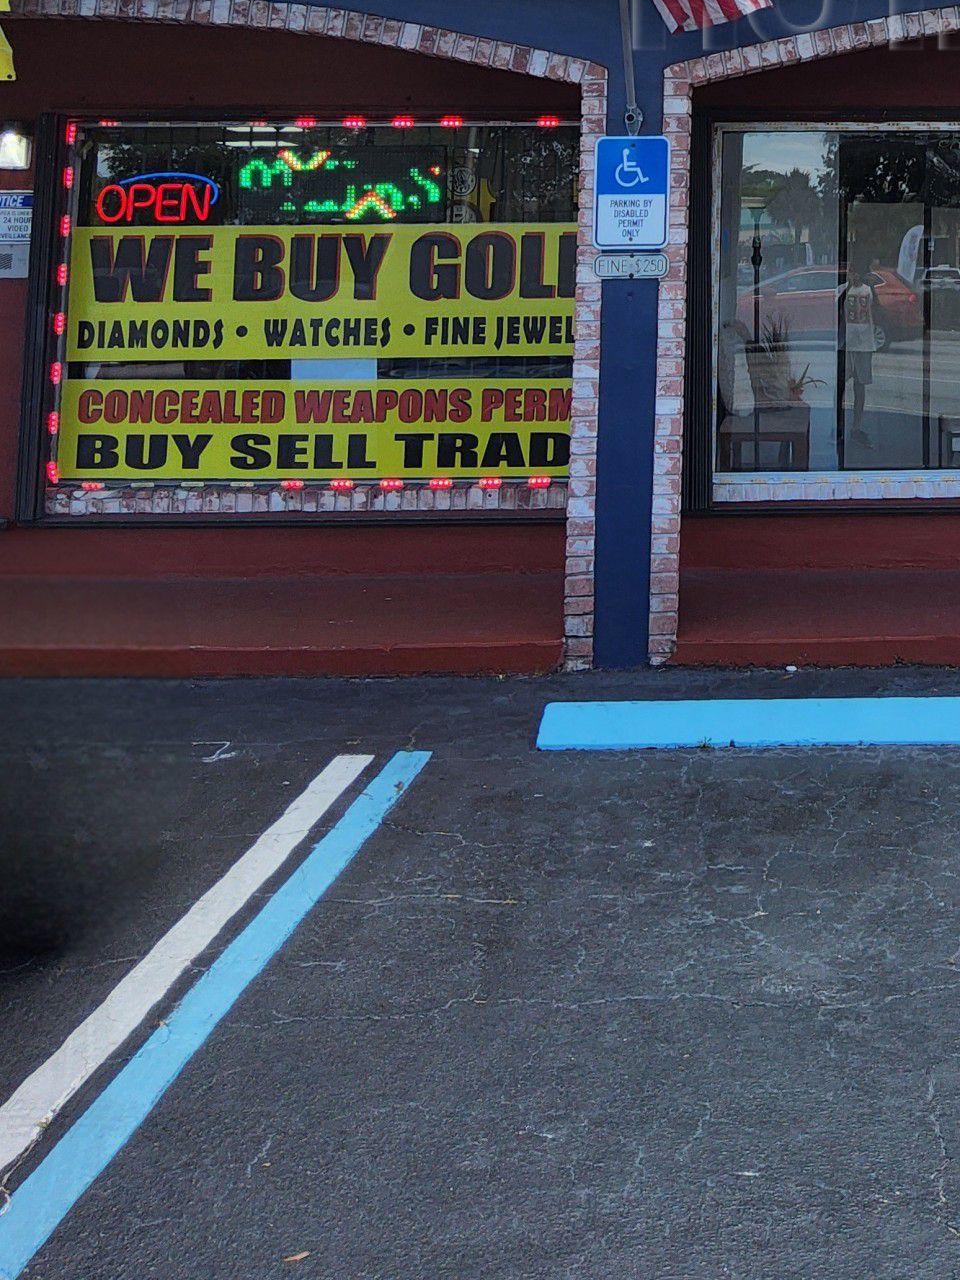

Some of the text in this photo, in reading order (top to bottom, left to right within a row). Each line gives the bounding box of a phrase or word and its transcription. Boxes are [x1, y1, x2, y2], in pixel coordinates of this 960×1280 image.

[97, 183, 212, 223] OPEN
[610, 200, 653, 208] PARKING BY
[613, 209, 649, 218] DISABLED
[618, 219, 644, 228] PERMIT
[622, 229, 640, 237] ONLY
[90, 234, 214, 303] WE
[233, 233, 393, 302] BUY
[598, 260, 627, 273] FINE
[76, 319, 223, 350] DIAMONDS
[264, 317, 391, 348] WATCHES
[424, 316, 487, 346] FINE
[77, 389, 286, 424] CONCEALED
[294, 388, 472, 424] WEAPONS
[75, 434, 214, 470] BUY
[229, 433, 377, 470] SELL
